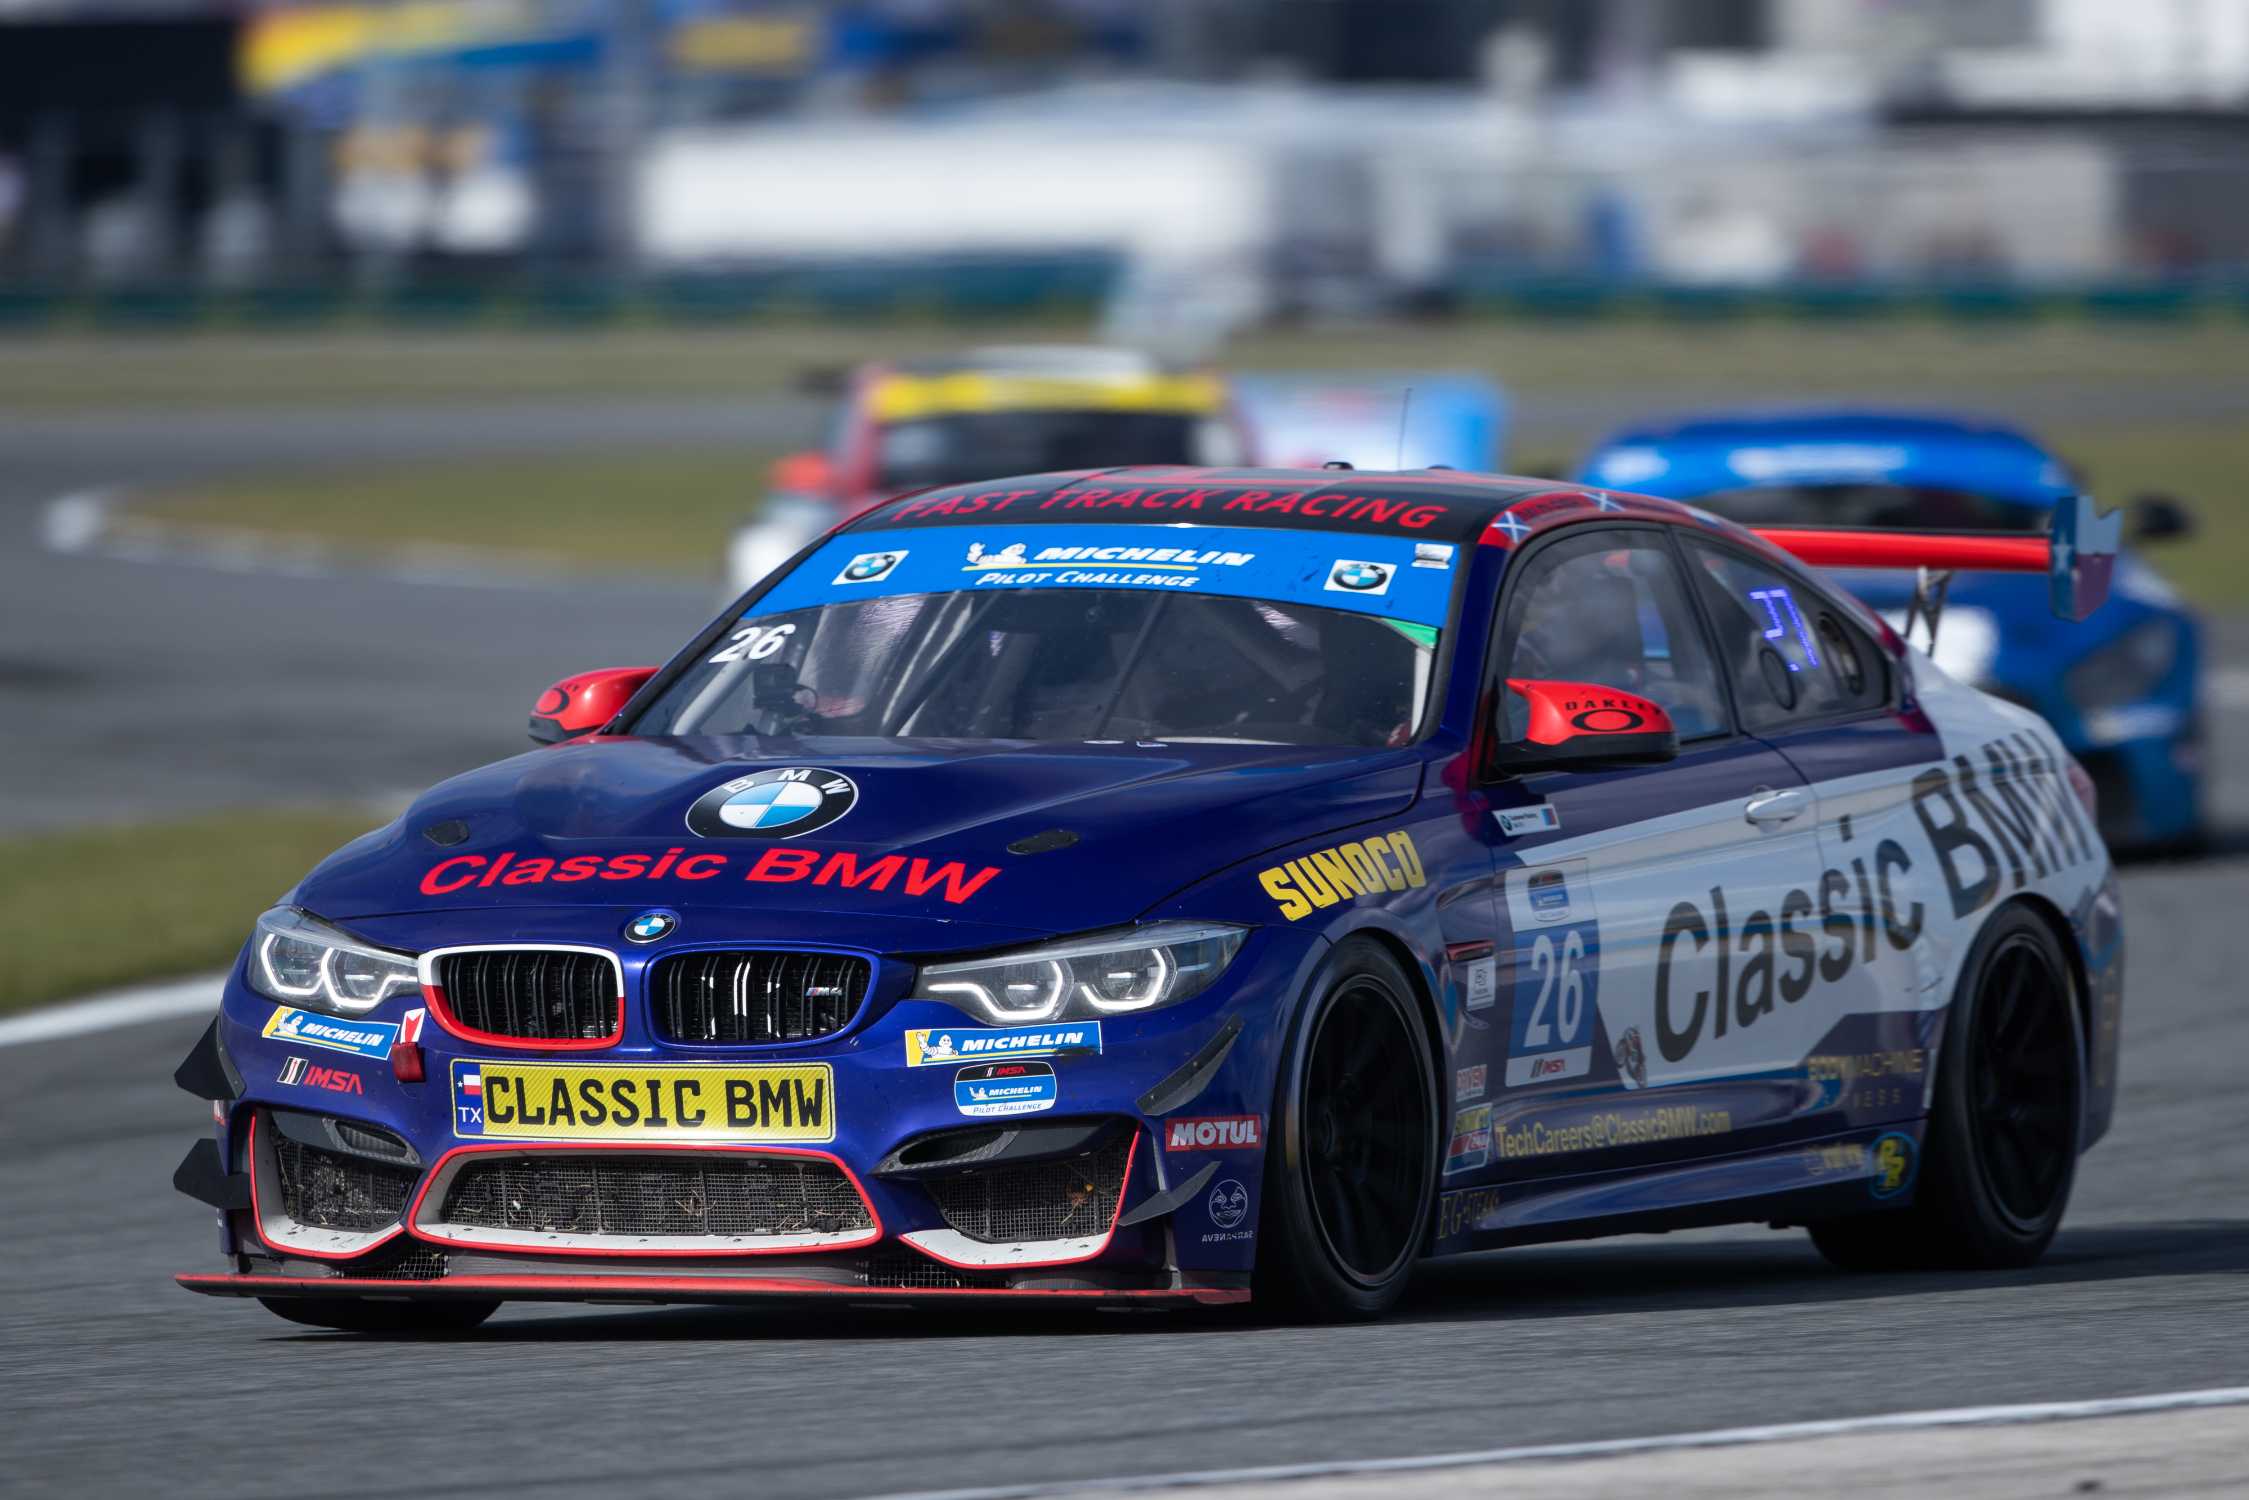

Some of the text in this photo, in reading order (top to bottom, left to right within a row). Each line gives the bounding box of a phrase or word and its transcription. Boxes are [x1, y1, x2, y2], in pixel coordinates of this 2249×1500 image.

[889, 488, 1448, 529] FAST TRACK RACING
[1033, 546, 1255, 567] MICHELIN
[974, 570, 1200, 588] PILOT CHALLENGE
[708, 623, 797, 664] 26
[723, 768, 850, 796] BMW
[418, 846, 1002, 905] Classic BMW
[1258, 830, 1427, 922] SUNOCO
[1655, 815, 1925, 1063] Classic
[1911, 728, 2094, 921] BMW
[1523, 929, 1585, 1048] 26
[300, 1021, 385, 1048] MICHELIN
[961, 1031, 1084, 1052] MICHELIN
[303, 1064, 365, 1096] IMSA
[988, 1085, 1043, 1097] MICHELIN
[457, 1105, 482, 1124] TX
[484, 1076, 824, 1128] CLASSIC BMW
[1170, 1120, 1258, 1147] MOTUL
[1495, 1105, 1731, 1158] TechCareers@ClassicBMW.com
